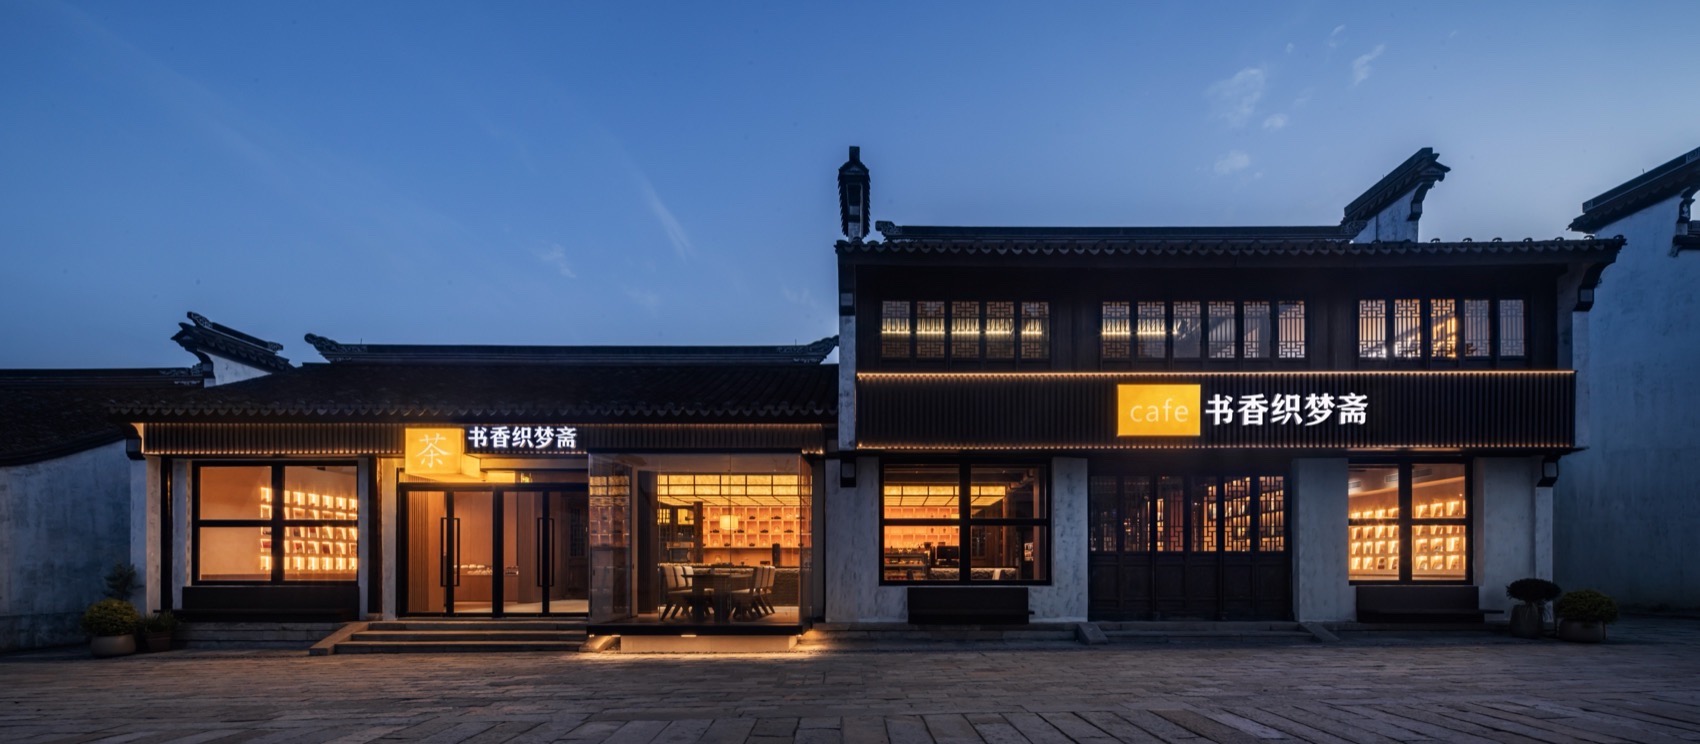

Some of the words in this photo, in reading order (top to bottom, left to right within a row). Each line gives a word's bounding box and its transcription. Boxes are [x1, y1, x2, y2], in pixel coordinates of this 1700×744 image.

[1130, 398, 1189, 422] cafe
[1205, 393, 1369, 426] 书香织梦斋
[415, 432, 452, 468] 茶
[467, 426, 577, 449] 书香织梦斋
